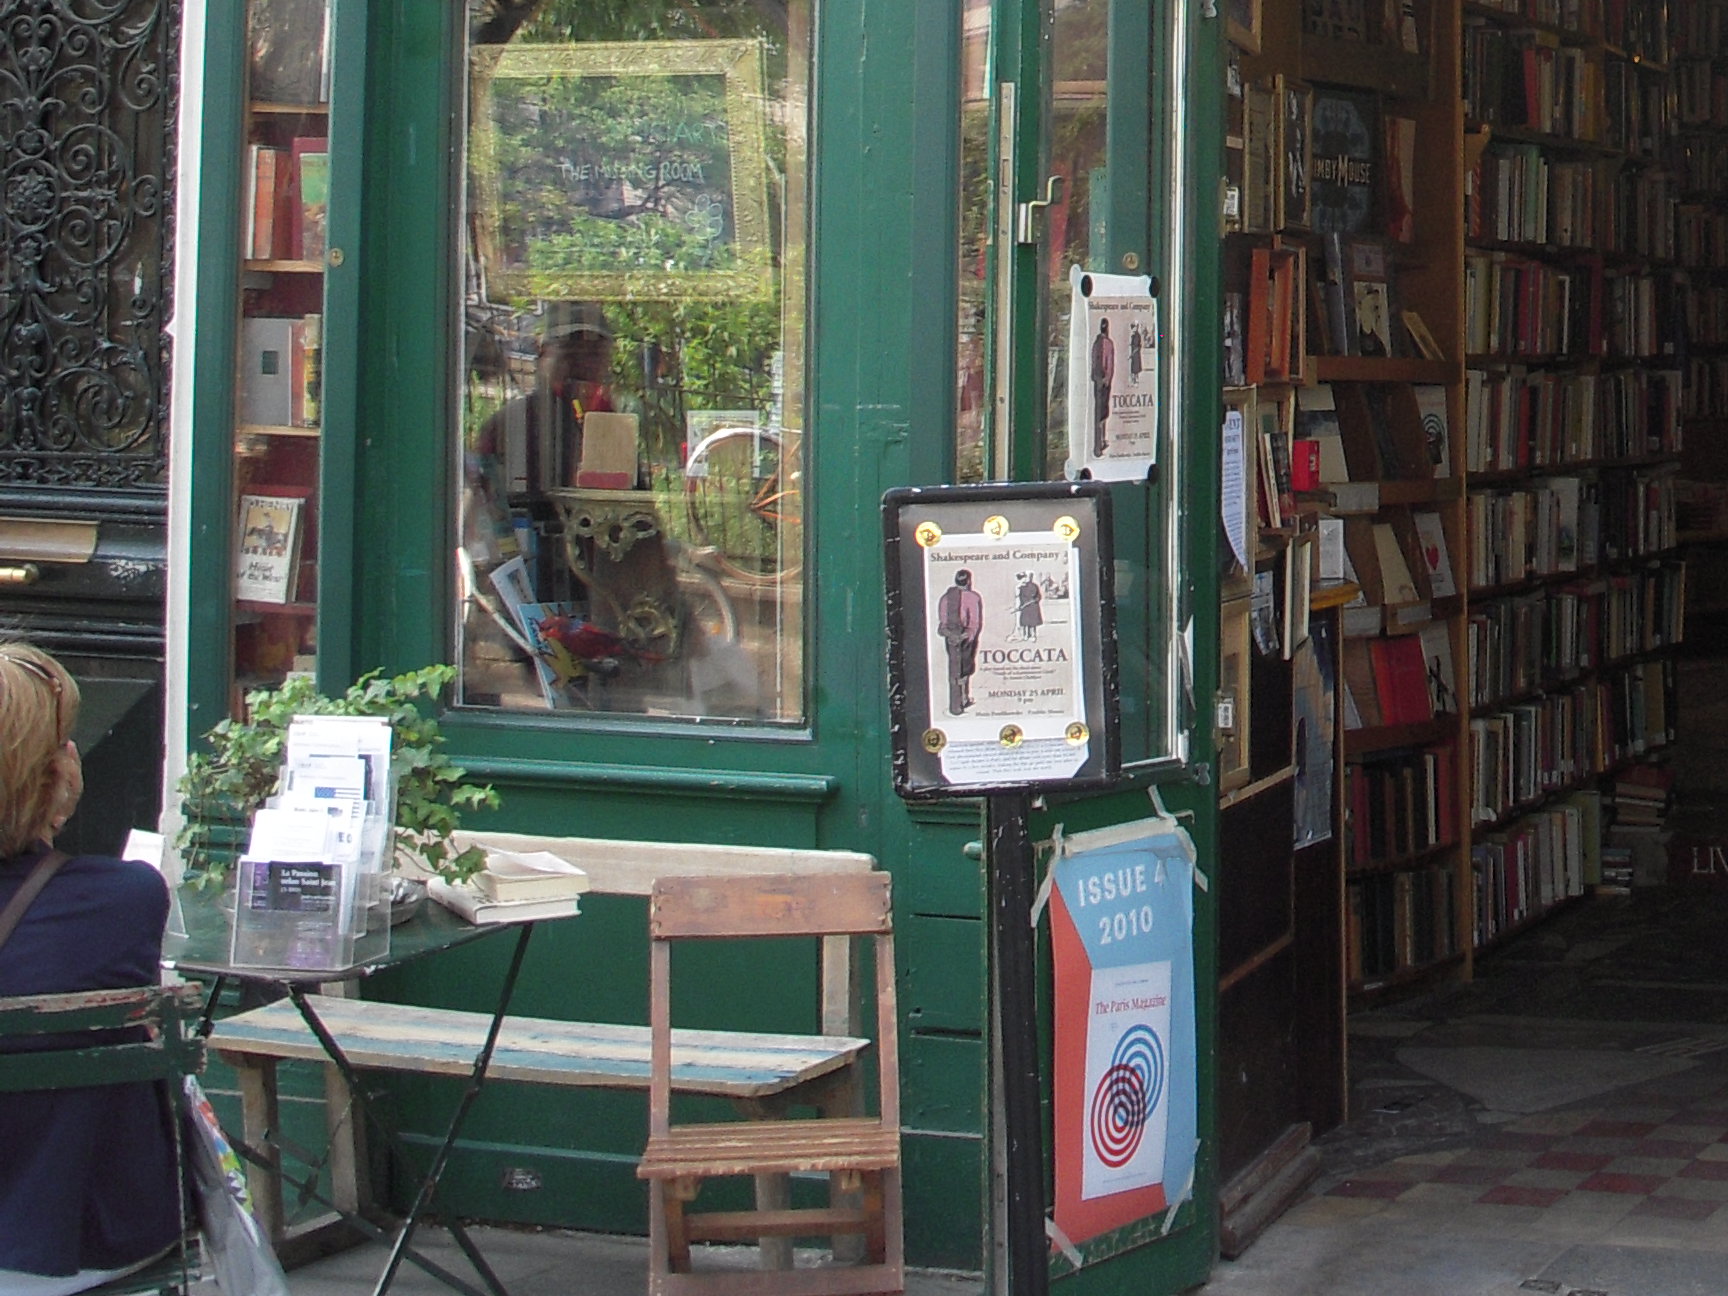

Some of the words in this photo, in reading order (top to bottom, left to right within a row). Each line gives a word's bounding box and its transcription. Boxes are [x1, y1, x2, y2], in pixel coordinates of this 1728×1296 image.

[1112, 394, 1153, 408] TOCCATA
[931, 551, 990, 563] Shakespeare
[991, 550, 1009, 560] and
[1012, 550, 1059, 562] Company
[980, 648, 1068, 664] TOCCATA
[988, 690, 1027, 698] MONDAY
[1078, 863, 1147, 907] ISSUE
[1099, 905, 1153, 945] 2010
[1110, 1000, 1130, 1014] Paris
